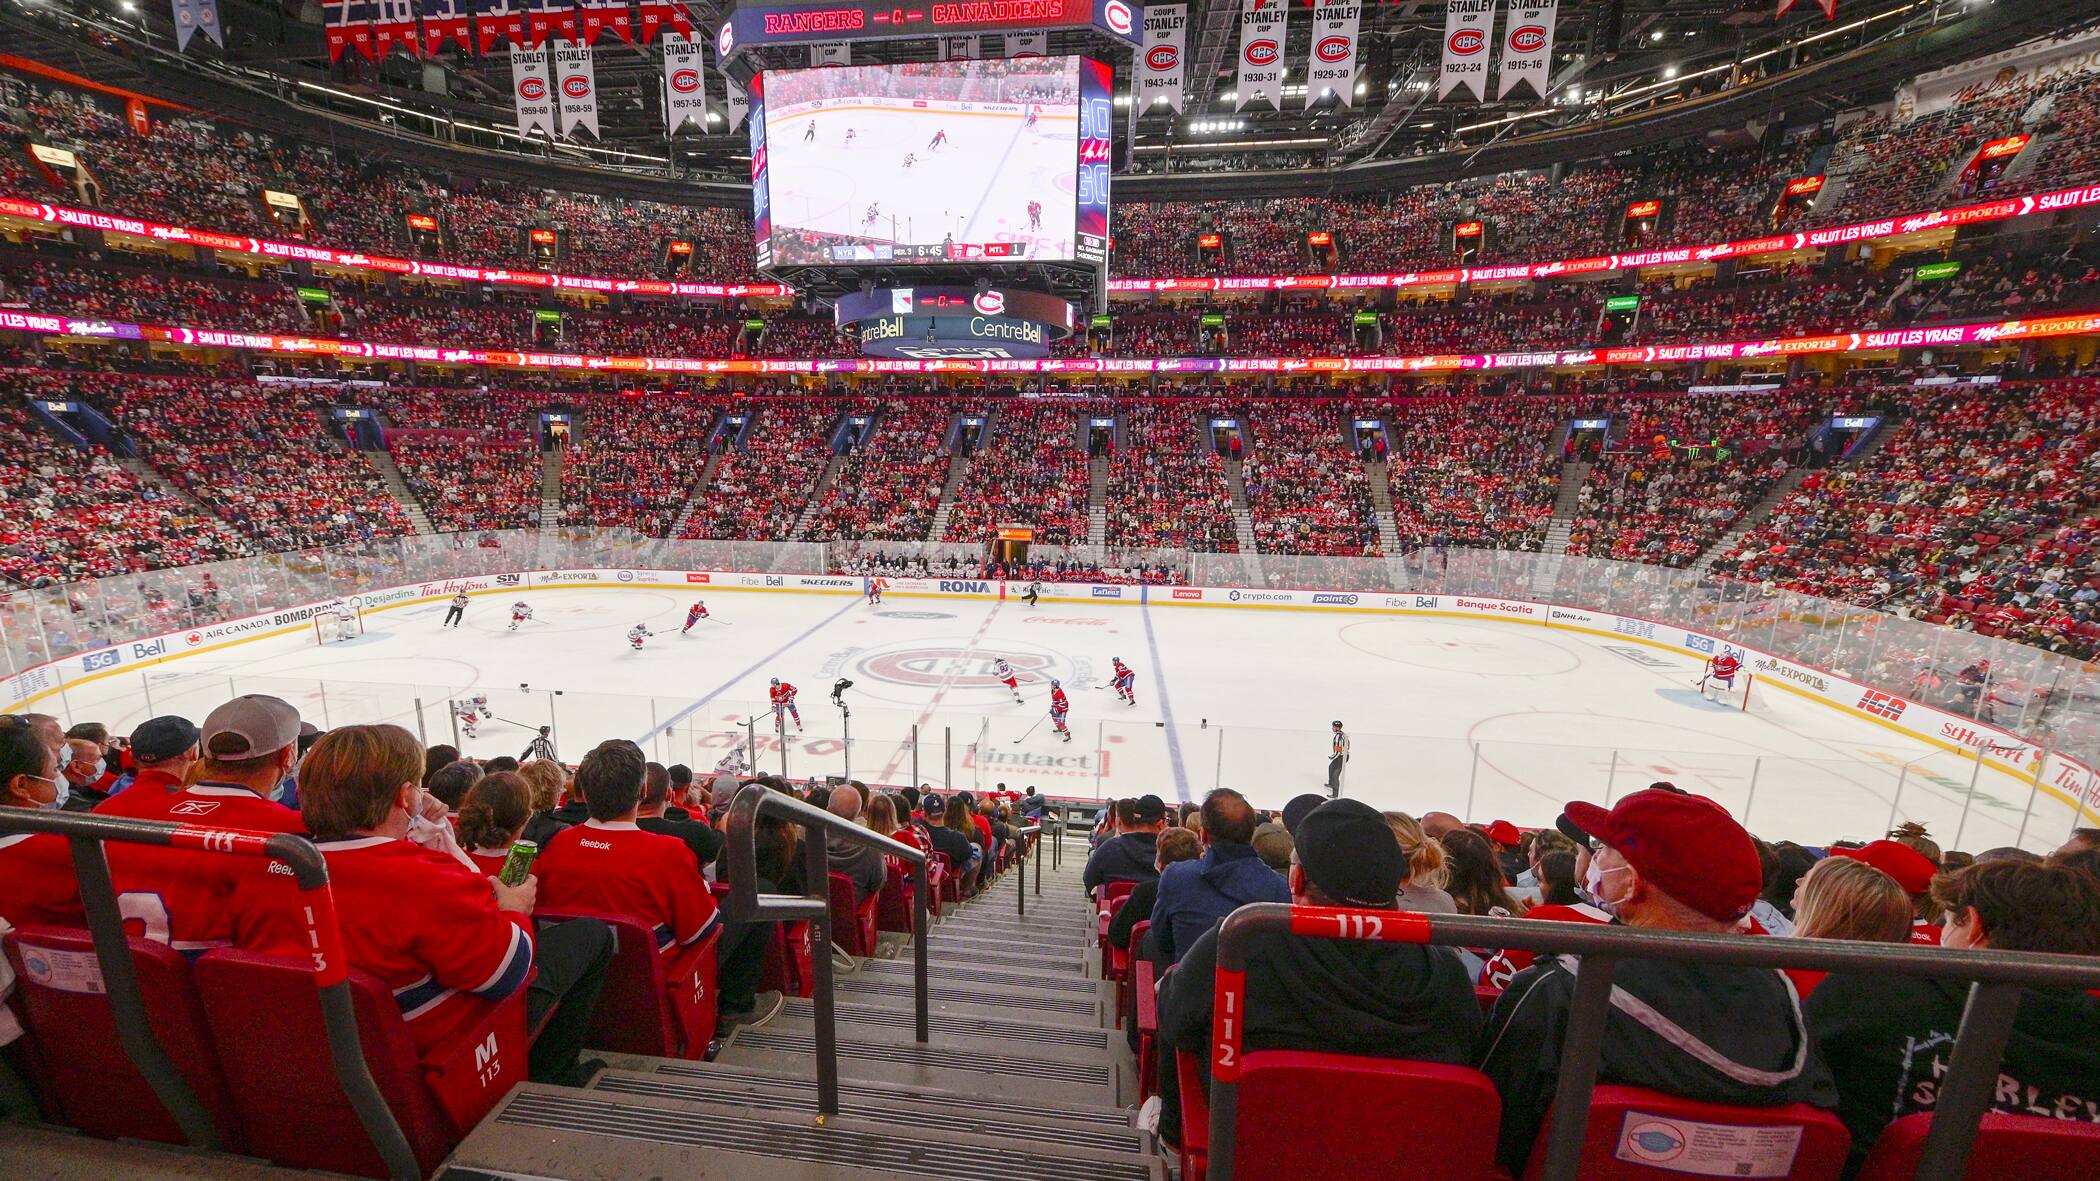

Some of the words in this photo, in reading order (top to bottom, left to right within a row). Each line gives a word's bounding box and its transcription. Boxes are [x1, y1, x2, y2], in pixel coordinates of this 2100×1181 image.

[1153, 7, 1176, 16] COUPE
[1449, 0, 1494, 13] STANLEY
[765, 10, 865, 34] RANGERS
[932, 0, 1063, 24] CANADIENS
[1243, 10, 1287, 24] STANLEY
[1315, 6, 1360, 21] STANLEY
[1462, 14, 1478, 22] CUP
[1524, 10, 1540, 19] CUP
[1143, 16, 1185, 31] STANLEY
[1256, 24, 1272, 33] CUP
[1328, 20, 1344, 29] CUP
[1156, 31, 1171, 39] CUP
[952, 42, 966, 50] CUP
[1019, 38, 1033, 46] CUP
[665, 43, 700, 55] STANLEY
[825, 49, 838, 57] CUP
[512, 51, 546, 64] STANLEY
[556, 50, 591, 62] STANLEY
[524, 64, 536, 72] CUP
[1445, 62, 1482, 73] 1923-24
[1507, 59, 1543, 70] 1915-16
[1243, 73, 1278, 82] 1930-31
[1313, 69, 1349, 80] 1929-30
[1143, 78, 1178, 88] 1943-44
[673, 99, 702, 108] 1957-58
[733, 97, 749, 106] 1956
[520, 106, 548, 115] 1959-60
[564, 104, 593, 113] 1958-59
[2038, 189, 2078, 209] SALUT
[59, 209, 92, 224] SALUT
[95, 215, 112, 228] LES
[112, 218, 145, 234] VRAIS!
[1810, 230, 1843, 245] SALUT
[1841, 226, 1861, 240] LES
[1861, 221, 1894, 236] VRAIS!
[1901, 211, 1949, 232] Molson
[264, 242, 290, 255] SALUT
[290, 246, 305, 258] LES
[305, 248, 332, 261] VRAIS!
[837, 249, 853, 257] NYR
[918, 245, 942, 256] 6:45
[989, 245, 1004, 254] MTL
[1621, 253, 1647, 266] SALUT
[1646, 252, 1662, 264] LES
[1662, 249, 1690, 262] VRAIS!
[422, 264, 446, 276] SALUT
[445, 267, 457, 277] LES
[457, 268, 479, 279] VRAIS!
[1472, 268, 1494, 280] SALUT
[1493, 267, 1506, 279] LES
[1506, 266, 1529, 278] VRAIS!
[5, 313, 26, 328] LES
[28, 316, 61, 331] VRAIS!
[197, 331, 227, 344] SALUT
[228, 333, 244, 346] LES
[244, 335, 273, 347] VRAIS!
[1866, 333, 1901, 347] SALUT
[1901, 331, 1923, 344] LES
[1925, 327, 1965, 343] VRAIS!
[1973, 321, 2028, 341] Molson
[1658, 348, 1687, 360] SALUT
[1686, 347, 1703, 359] LES
[1703, 344, 1734, 357] VRAIS!
[48, 402, 67, 411] Bell
[345, 409, 360, 417] Bell
[1582, 421, 1598, 429] Bell
[1844, 418, 1864, 428] Bell
[497, 574, 520, 585] SN
[741, 576, 759, 585] Fibe
[766, 576, 784, 586] Bell
[800, 578, 854, 587] SKECHERS
[419, 584, 441, 597] Tim
[443, 580, 489, 594] Hortons
[940, 580, 991, 593] RONA
[1093, 588, 1120, 597] Lafleur
[365, 589, 416, 606] Desjardins
[1175, 591, 1200, 599] Lenovo
[1243, 592, 1292, 602] crypto.com
[1386, 597, 1407, 607] Fibe
[1416, 596, 1438, 608] Bell
[1457, 599, 1498, 611] Banque
[1500, 602, 1534, 614] Scotia
[1561, 612, 1577, 620] NHL
[206, 628, 224, 639] AIR
[225, 619, 270, 636] CANADA
[1614, 617, 1656, 640] IBM
[1692, 636, 1709, 649] 5G
[91, 653, 114, 668] 5G
[133, 639, 167, 660] Bell
[1856, 689, 1908, 721] IGA
[987, 748, 1093, 769] intact
[2053, 761, 2084, 797] Tim
[579, 837, 612, 851] Reebok
[1335, 913, 1383, 940] 112
[693, 970, 702, 988] L
[693, 988, 705, 1004] 113
[475, 1031, 498, 1072] M
[479, 1060, 501, 1089] 113
